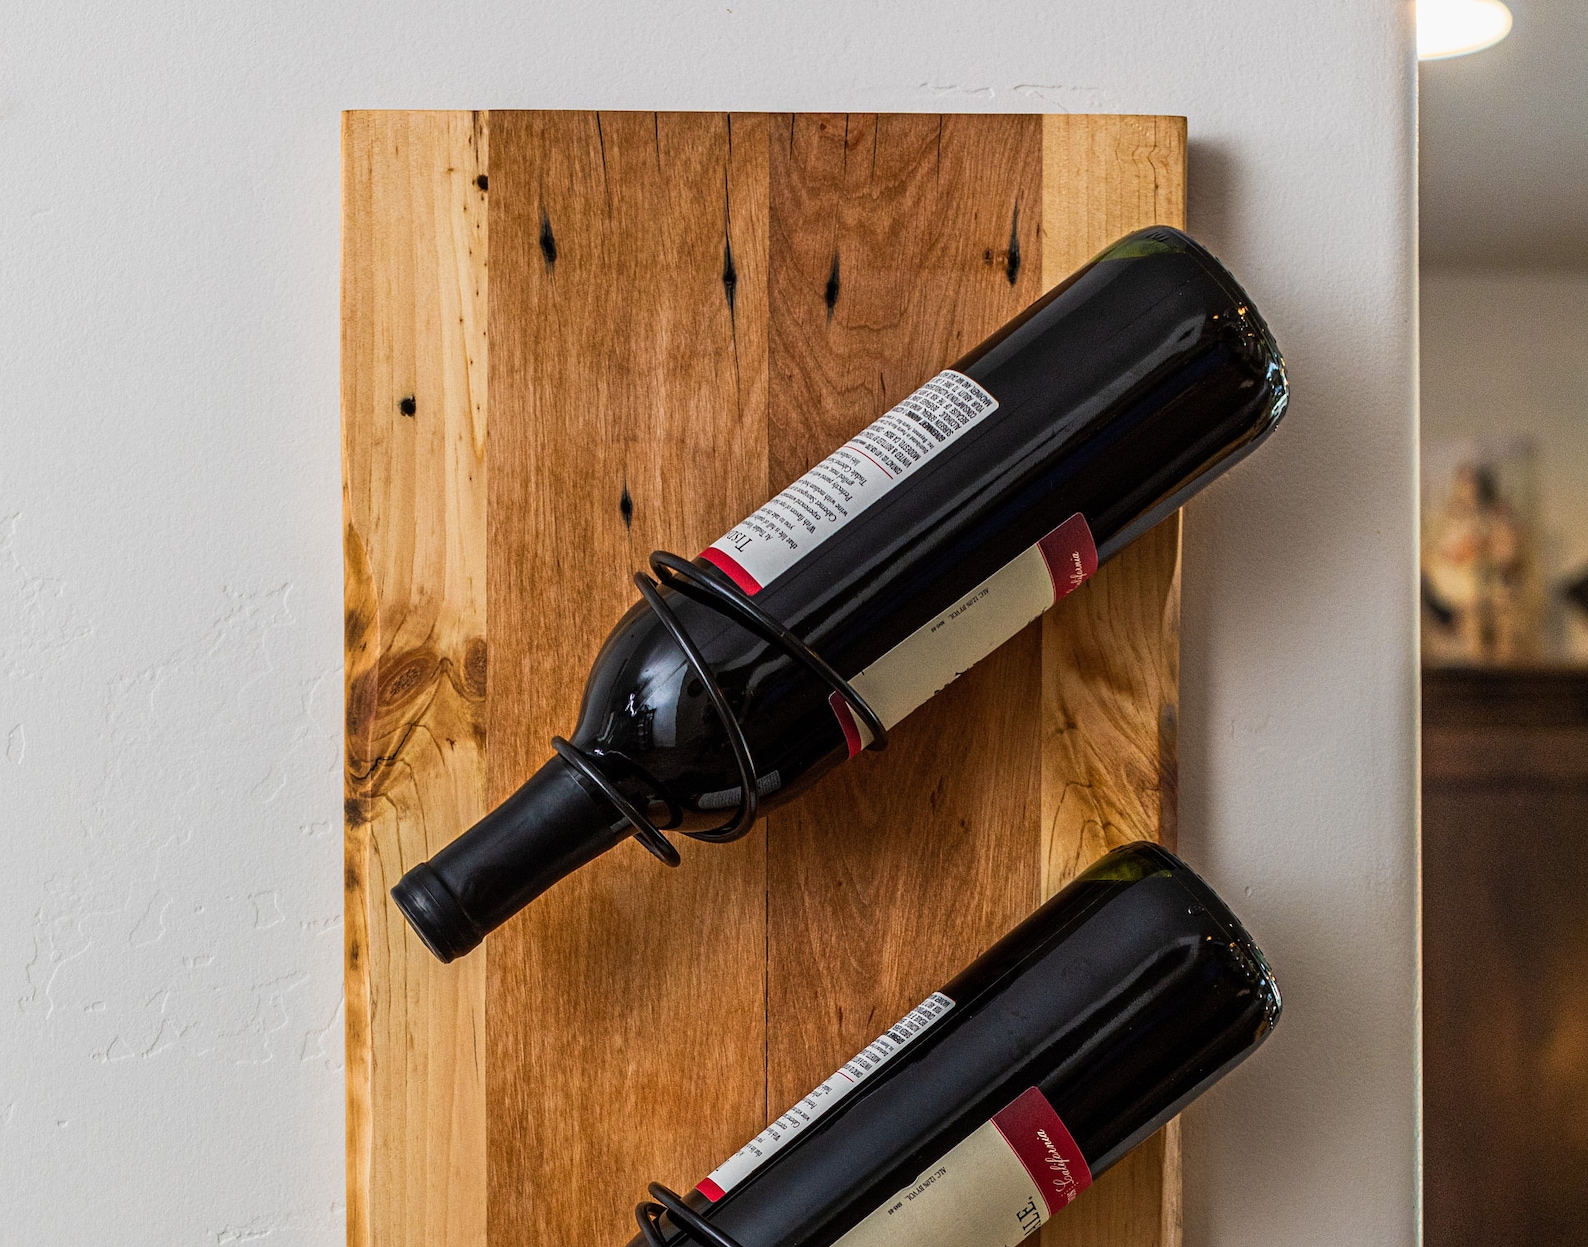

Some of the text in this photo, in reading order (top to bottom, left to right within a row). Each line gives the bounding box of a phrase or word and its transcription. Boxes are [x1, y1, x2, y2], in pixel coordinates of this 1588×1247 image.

[894, 451, 912, 468] VINTED
[849, 469, 867, 486] Tisdale
[822, 493, 836, 505] with
[830, 481, 853, 501] Perfectly
[788, 507, 805, 521] flavors
[813, 500, 837, 522] Cabernet
[834, 503, 848, 516] wine
[801, 518, 816, 533] With
[784, 537, 798, 549] that
[1037, 1129, 1074, 1192] California
